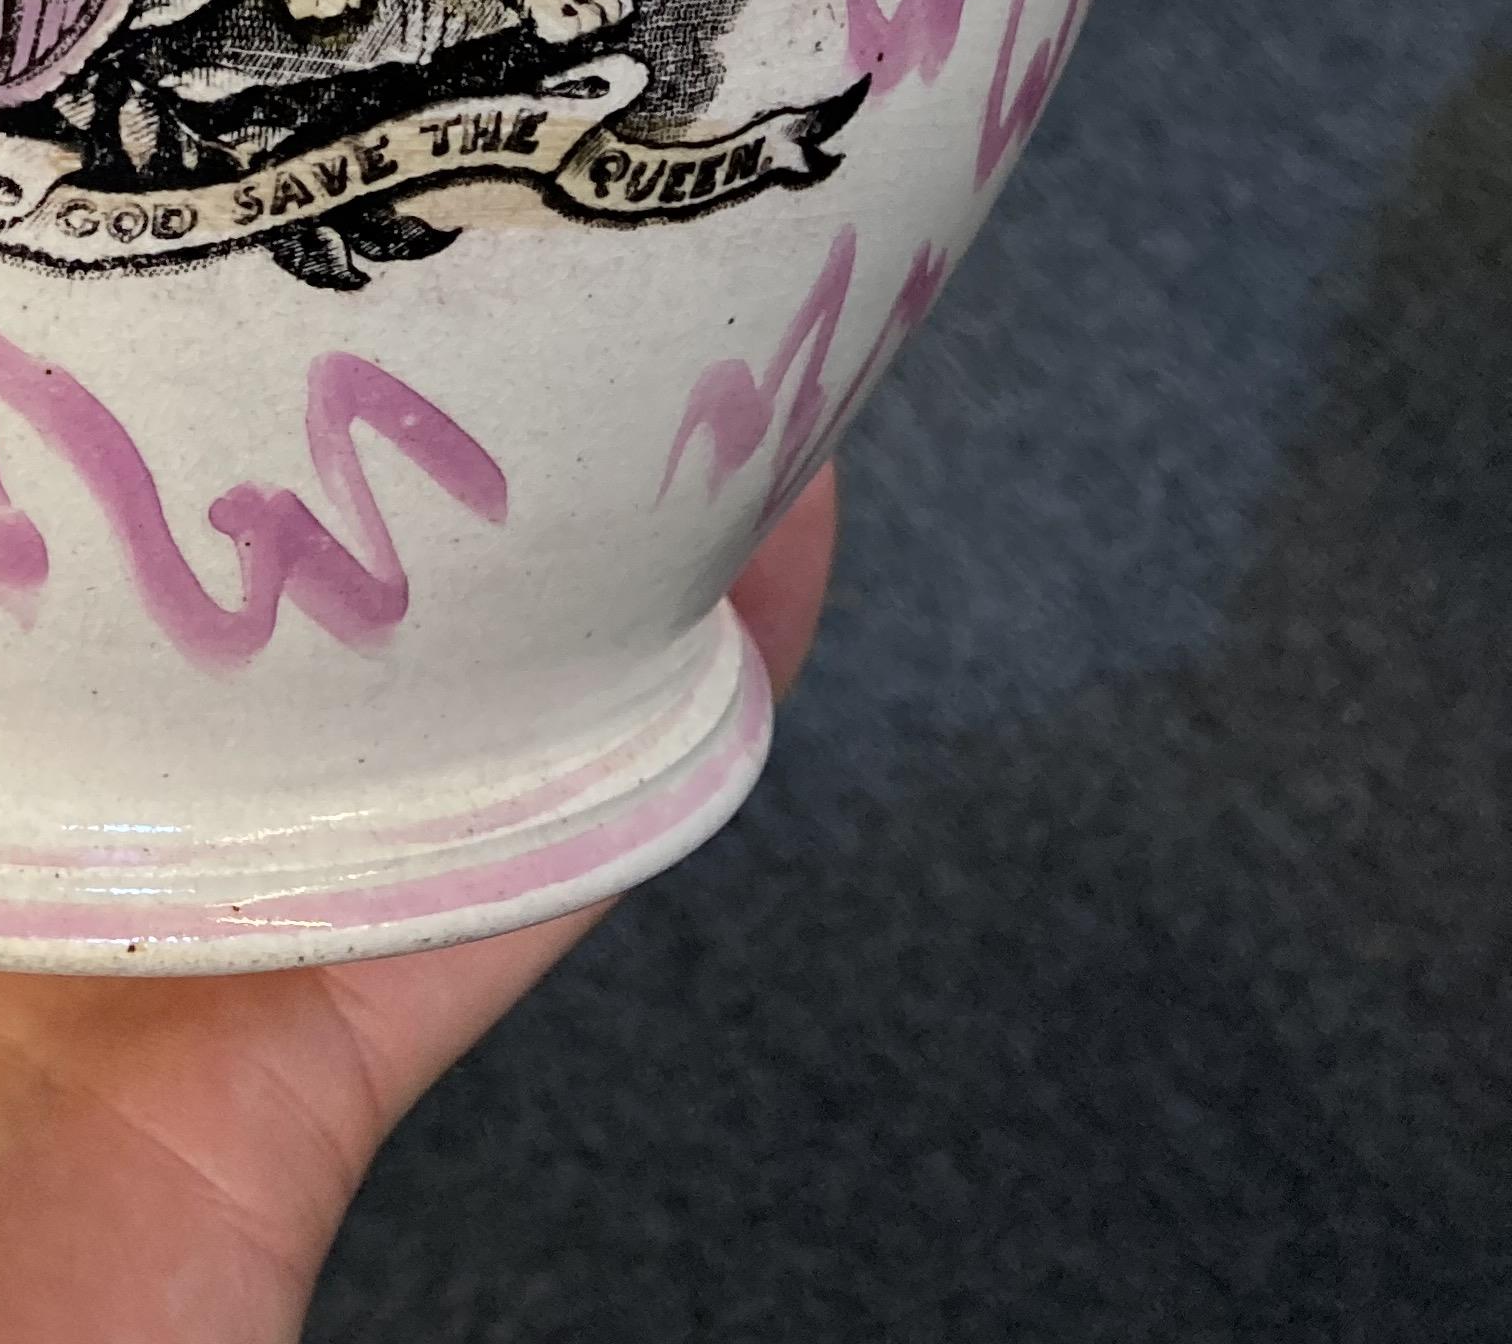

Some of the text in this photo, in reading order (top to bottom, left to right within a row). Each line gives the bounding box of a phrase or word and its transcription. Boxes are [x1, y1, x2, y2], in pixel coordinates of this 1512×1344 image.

[55, 197, 198, 243] GOD
[233, 134, 399, 226] SAVE
[419, 108, 548, 157] THE
